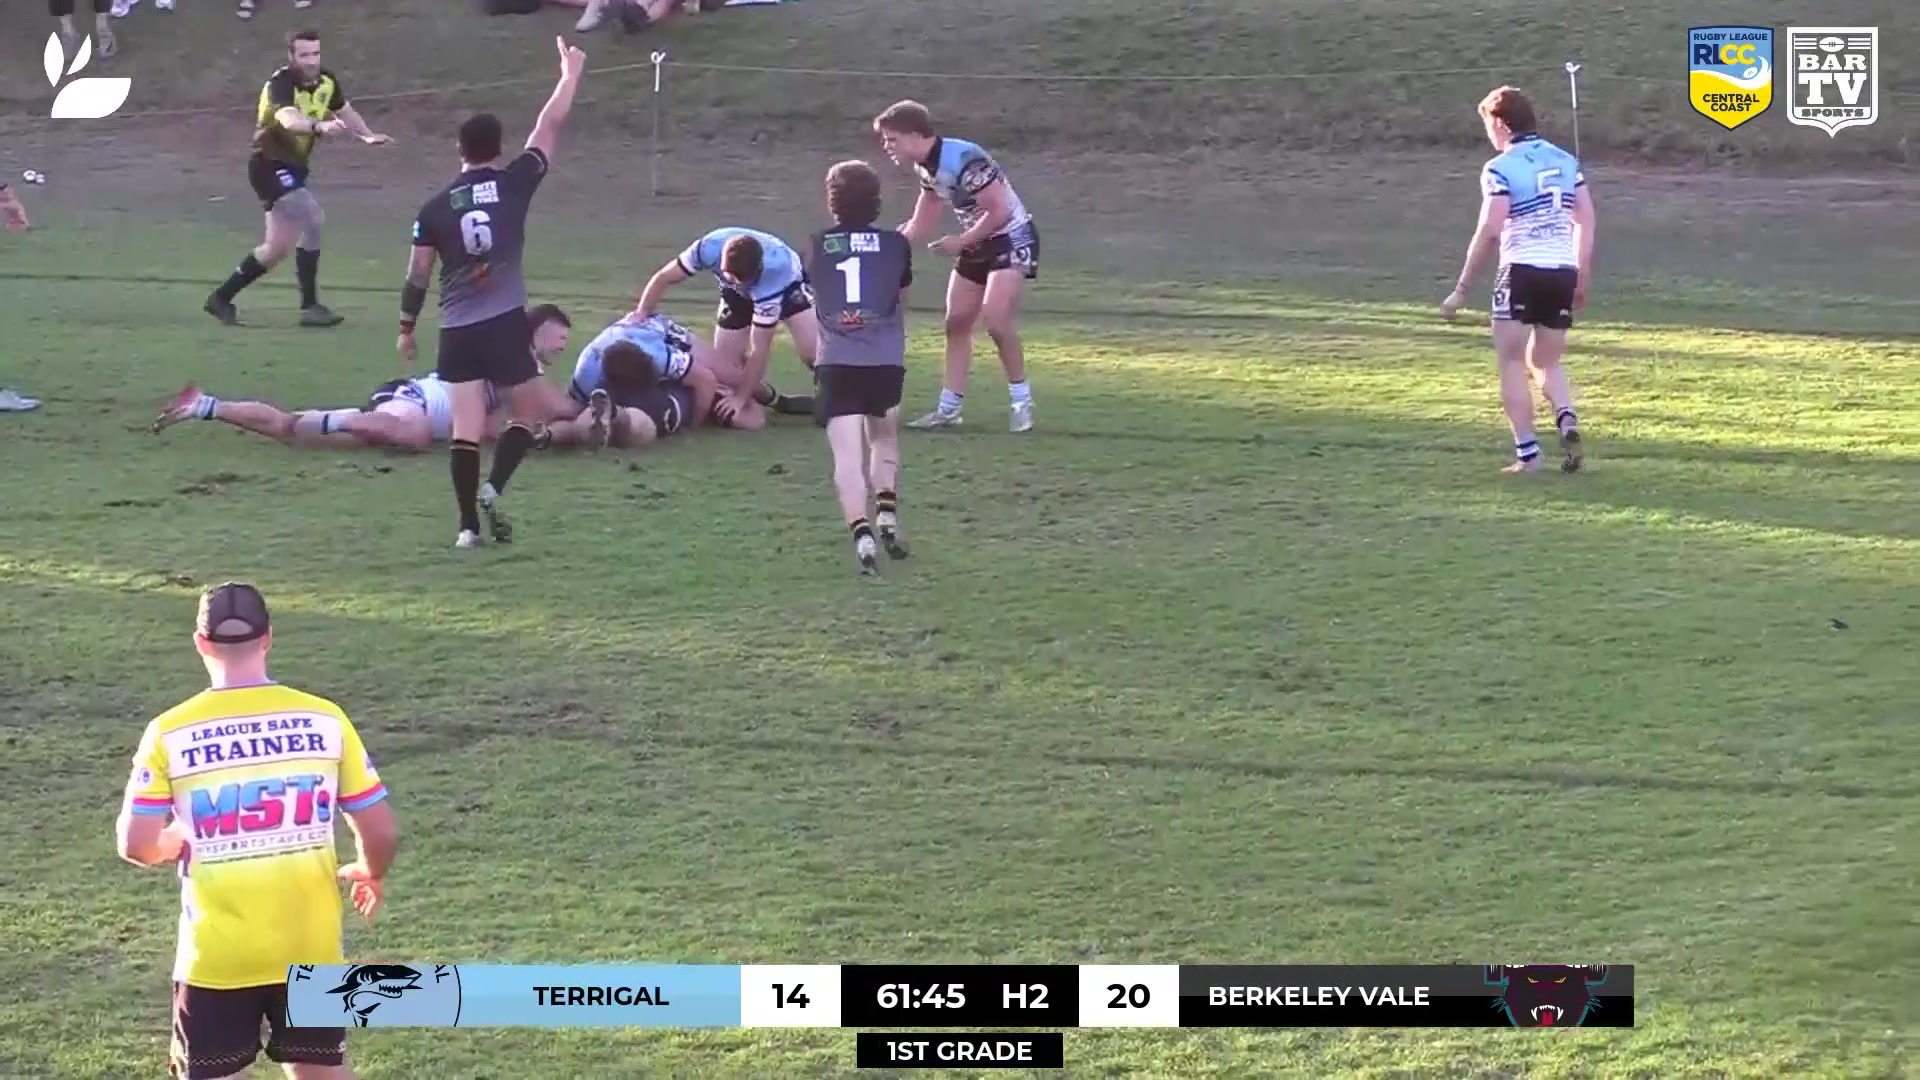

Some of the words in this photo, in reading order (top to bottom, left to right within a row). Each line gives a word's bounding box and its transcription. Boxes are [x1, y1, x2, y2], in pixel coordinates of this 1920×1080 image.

[1536, 168, 1562, 211] 5
[461, 209, 493, 256] 6
[835, 256, 861, 303] 1
[181, 733, 327, 768] TRAINER
[191, 722, 262, 742] LEAGUE
[267, 718, 312, 731] SAFE
